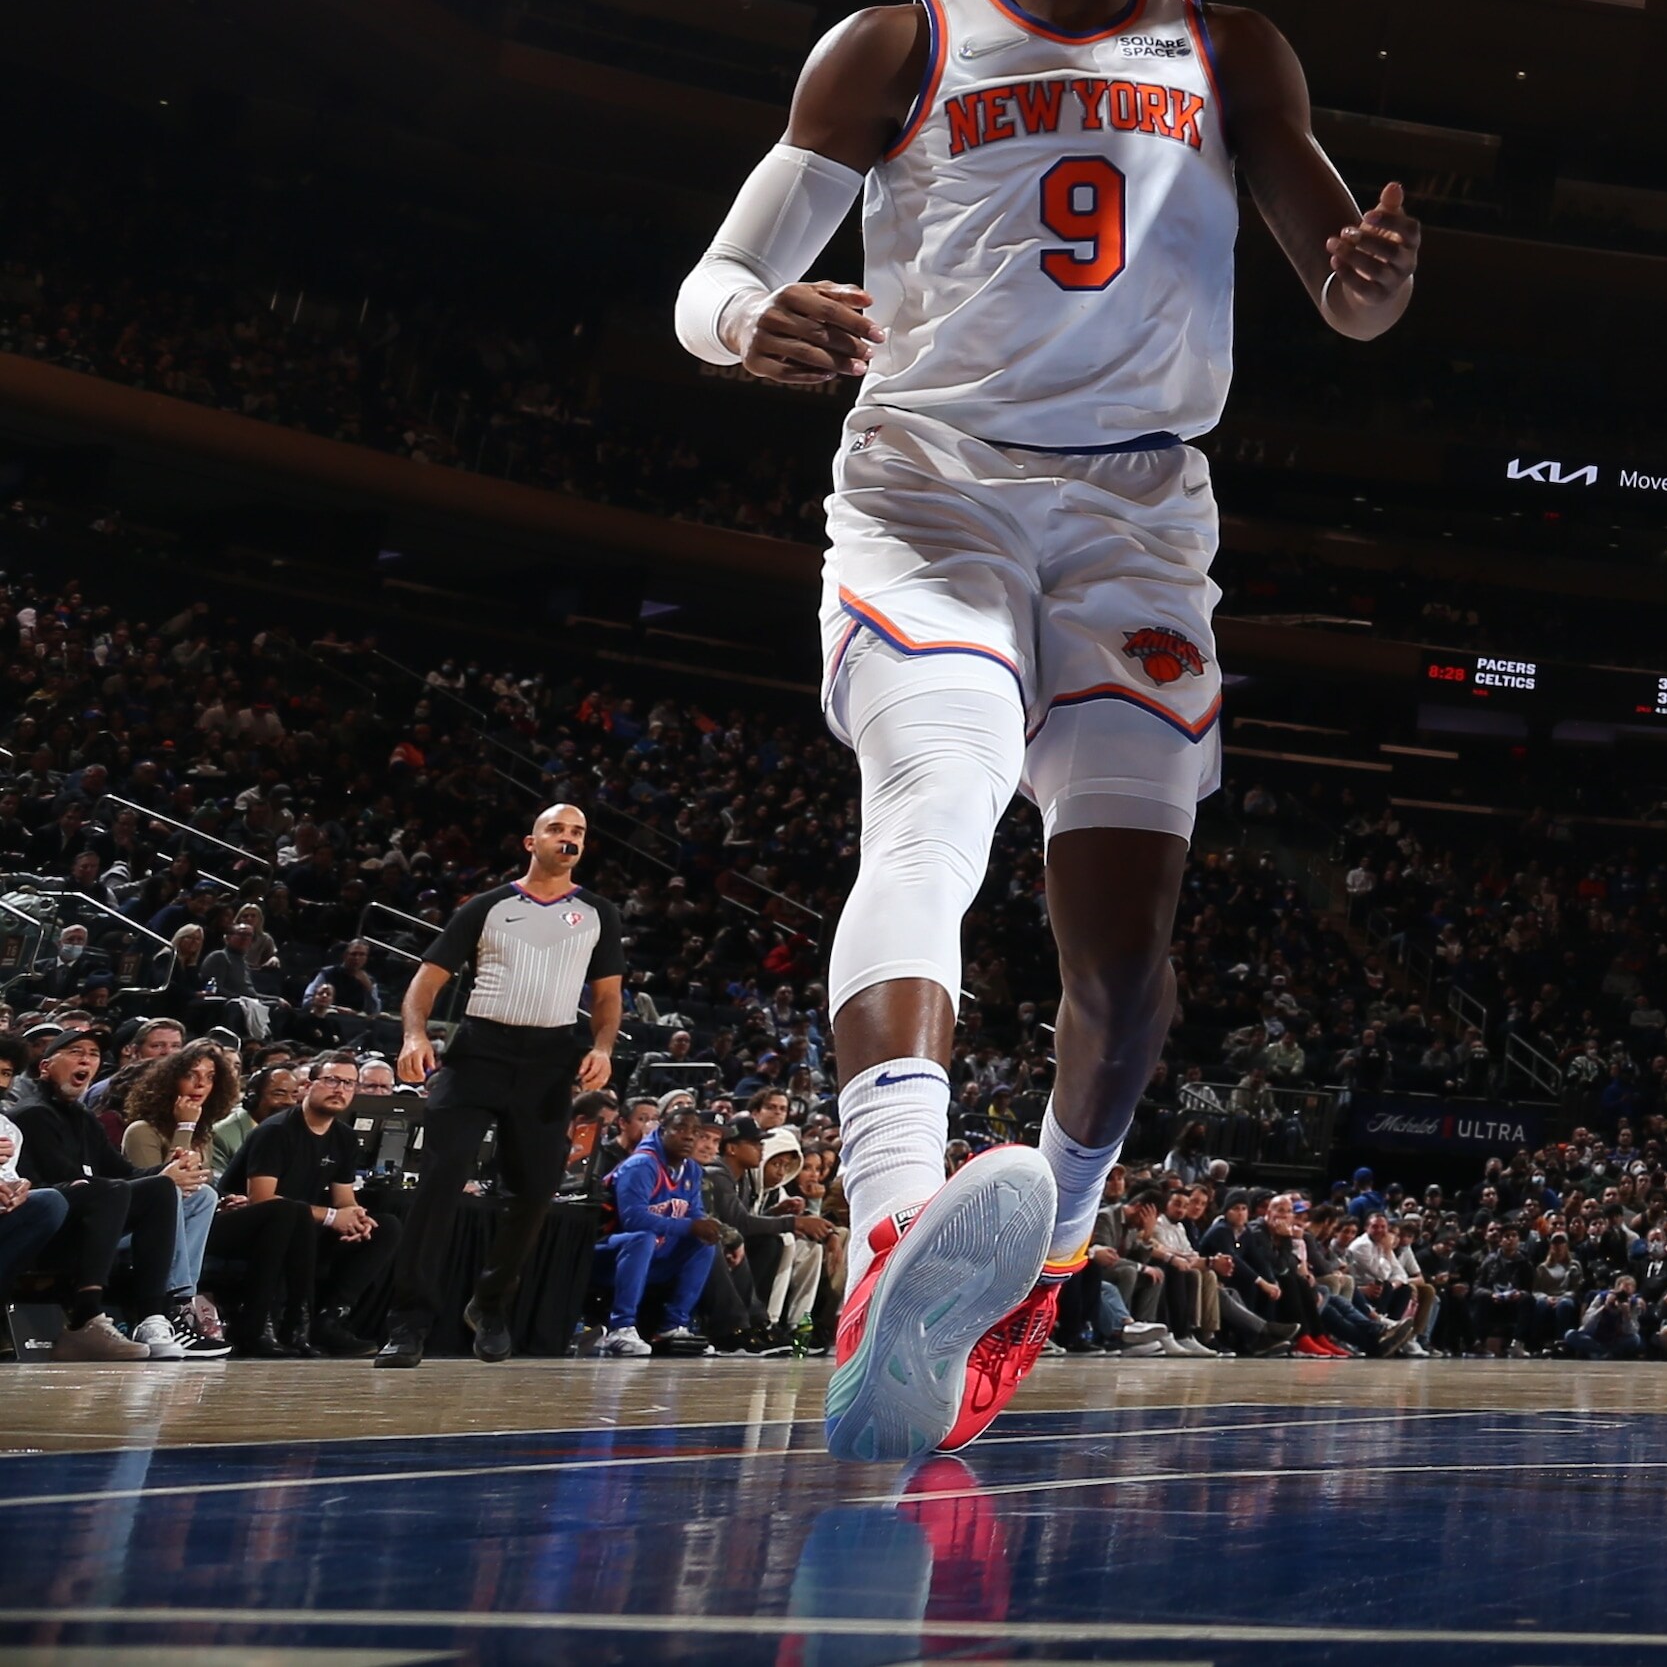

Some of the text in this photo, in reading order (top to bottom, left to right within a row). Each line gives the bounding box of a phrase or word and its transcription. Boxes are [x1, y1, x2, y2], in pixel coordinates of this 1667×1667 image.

[1120, 36, 1186, 48] SQUARE
[1123, 47, 1176, 58] SPACE
[945, 78, 1204, 159] NEW YORK
[1040, 155, 1126, 292] 9
[1427, 664, 1465, 682] 8:28
[1477, 657, 1536, 675] PACERS
[1474, 672, 1536, 690] CELTICS
[1367, 1112, 1527, 1142] Michelob ULTRA
